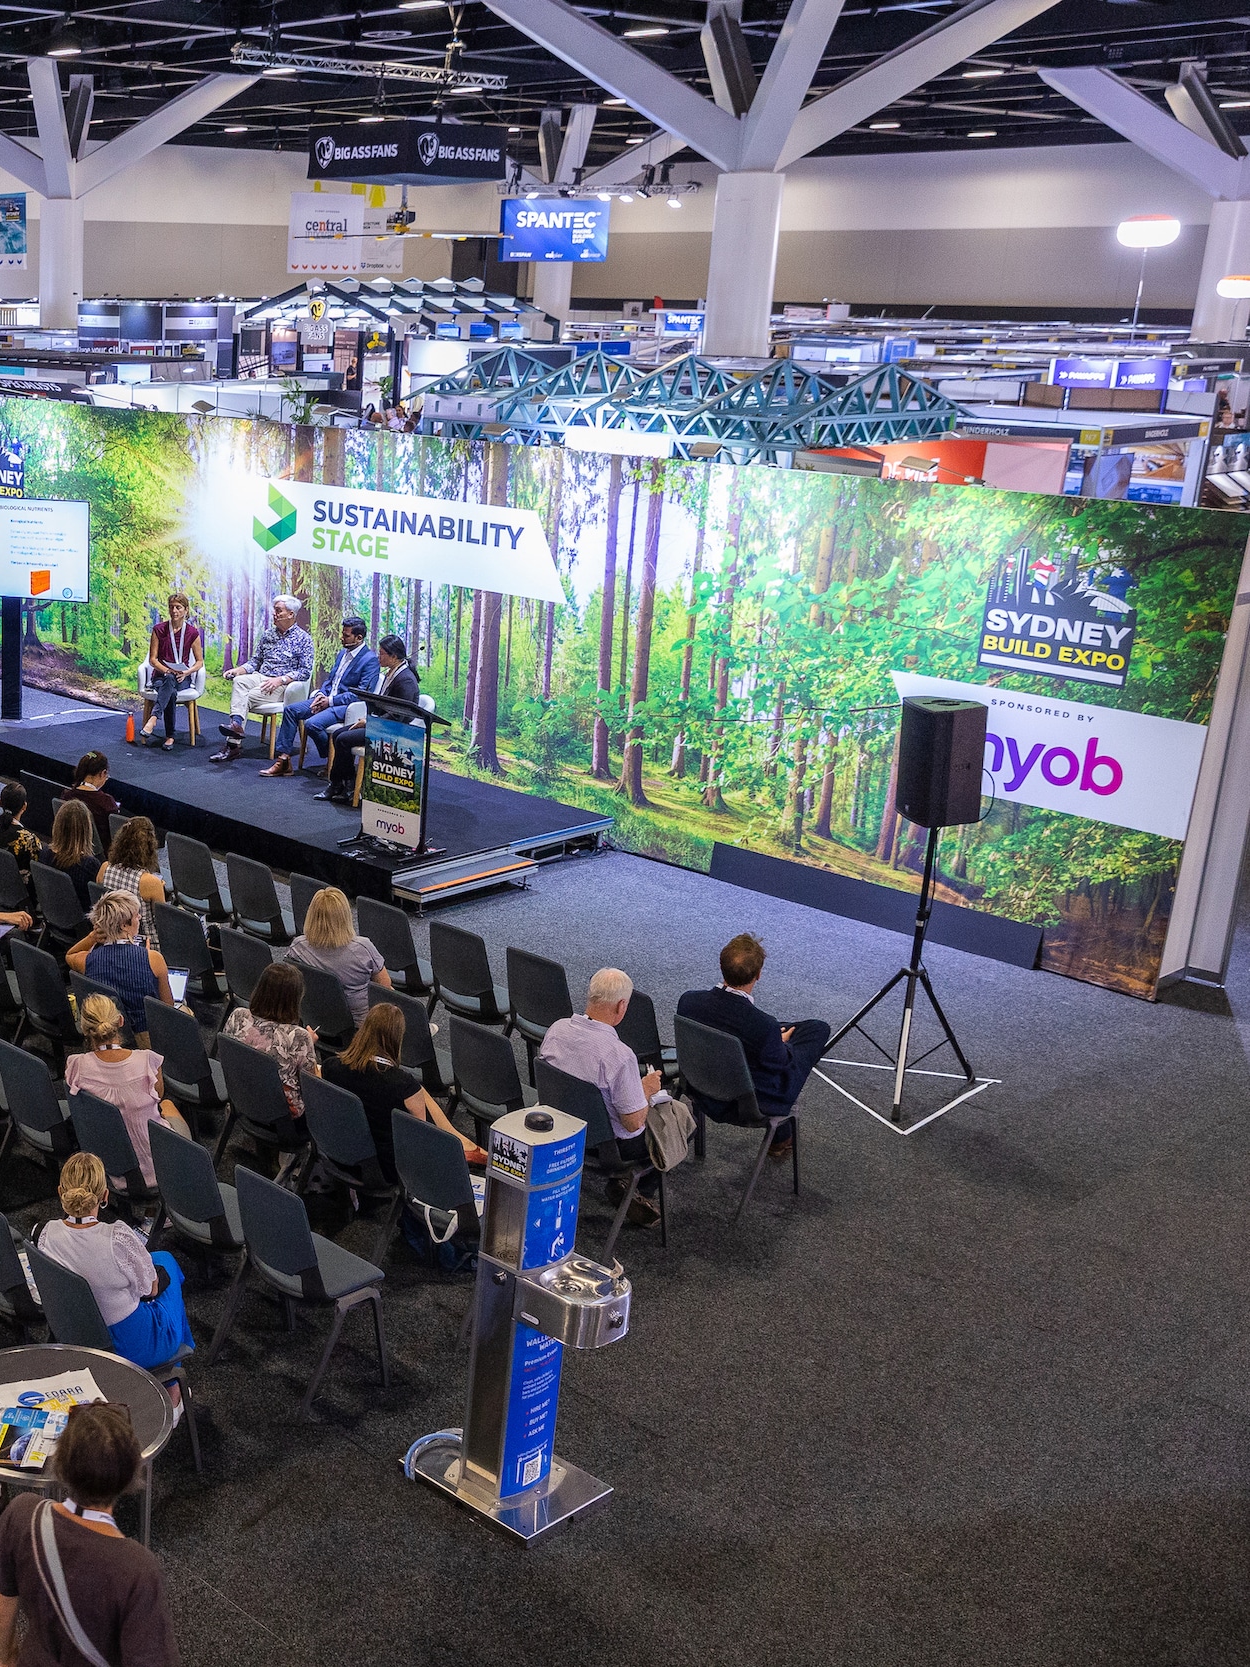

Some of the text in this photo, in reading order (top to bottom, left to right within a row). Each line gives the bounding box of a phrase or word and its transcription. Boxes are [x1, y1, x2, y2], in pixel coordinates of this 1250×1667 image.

[305, 219, 348, 232] central
[516, 211, 597, 229] SPANTEC
[0, 486, 23, 498] EXPO
[0, 504, 27, 512] BIOLOGICAL
[313, 500, 524, 550] SUSTAINABILITY
[312, 527, 389, 560] STAGE
[986, 608, 1132, 650] SYDNEY
[982, 635, 1125, 671] BUILD EXPO
[991, 699, 1095, 724] SPONSORED BY
[372, 761, 414, 780] SYDNEY
[372, 771, 414, 789] BUILD EXPO
[376, 819, 405, 835] myob
[492, 1160, 510, 1172] BUILD
[493, 1153, 527, 1173] SYDNEY
[524, 1354, 547, 1367] Premium
[547, 1346, 558, 1358] Event
[45, 1386, 84, 1399] EDARA
